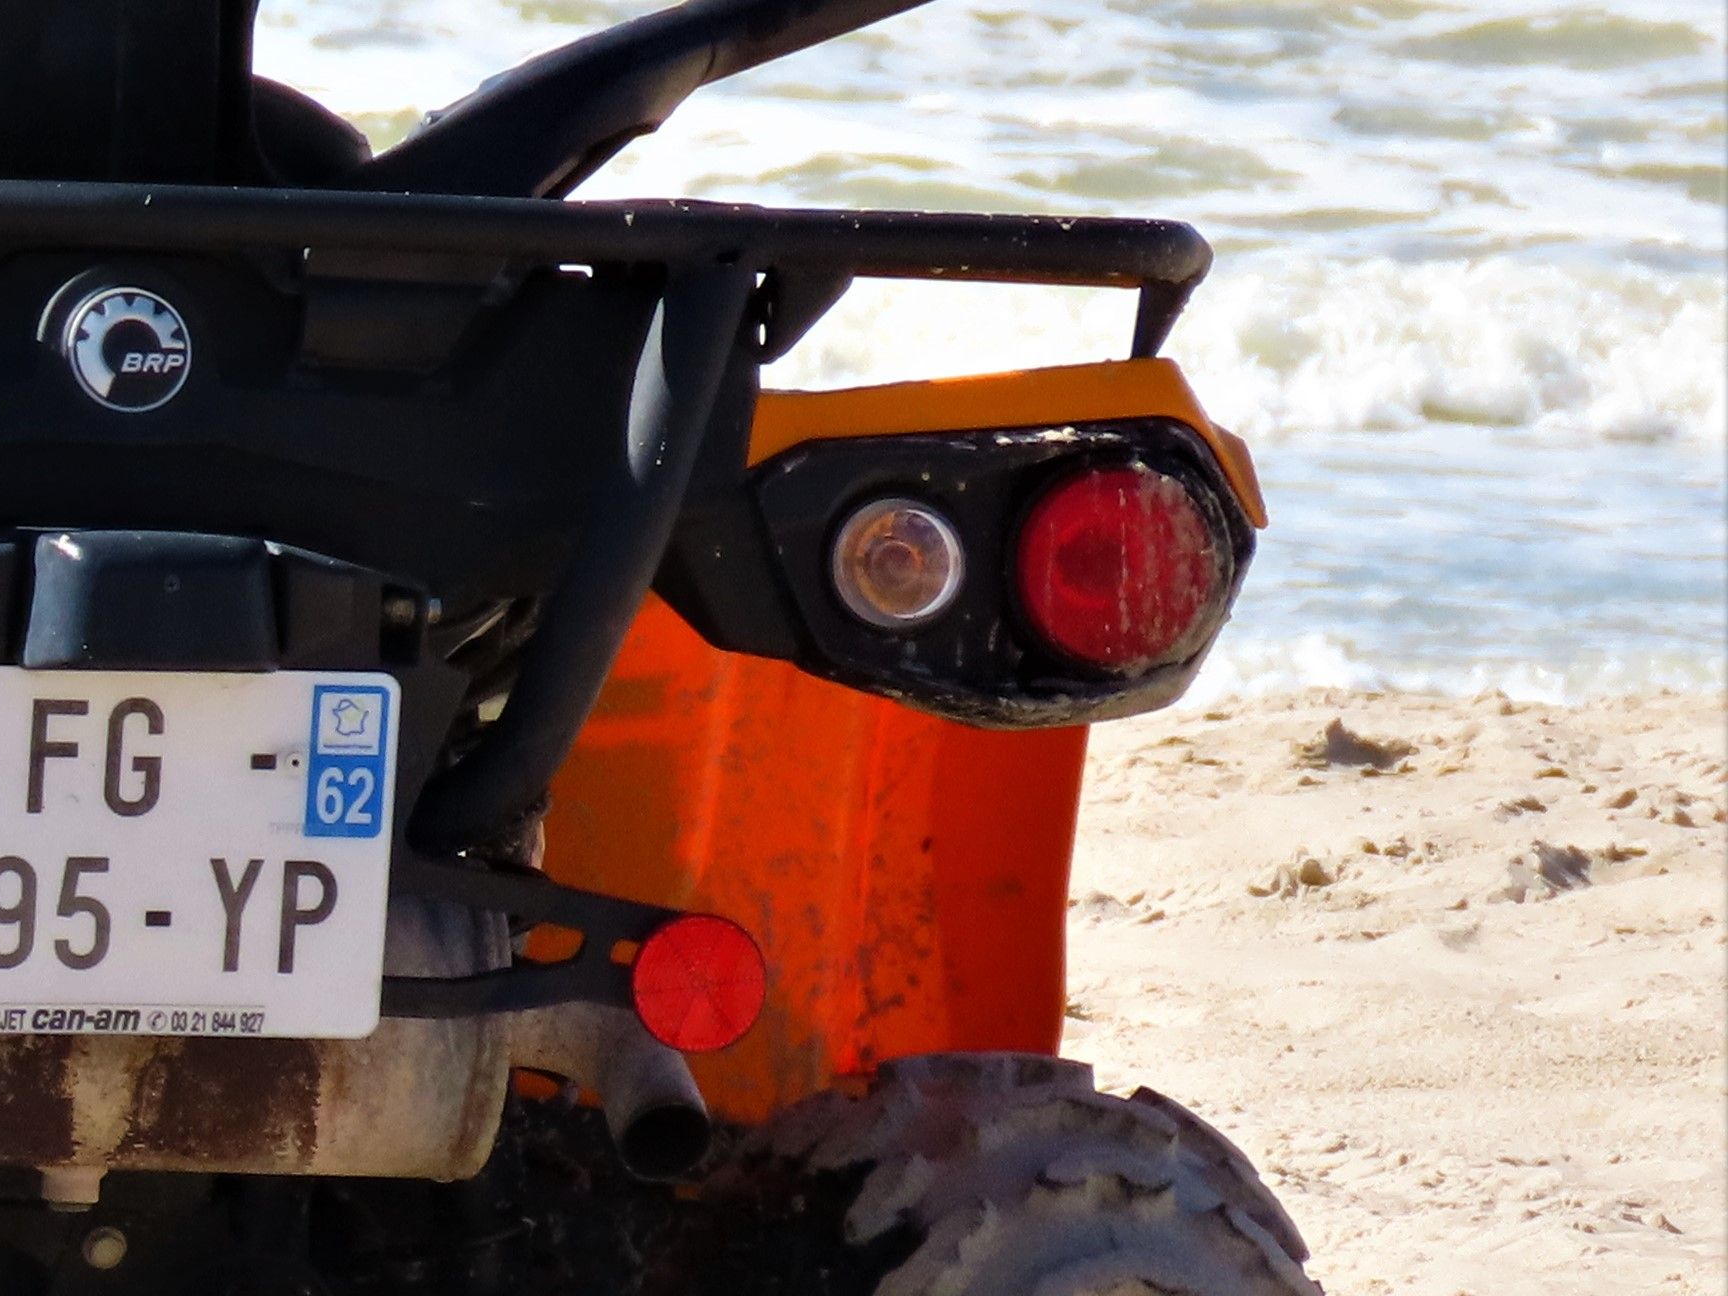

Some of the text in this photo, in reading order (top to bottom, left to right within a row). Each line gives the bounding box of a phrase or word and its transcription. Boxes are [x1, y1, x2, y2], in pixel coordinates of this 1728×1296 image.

[121, 353, 184, 373] BRP
[26, 697, 165, 818] FG
[316, 767, 374, 824] 62
[31, 1008, 142, 1032] can-am
[171, 1011, 189, 1032] 03
